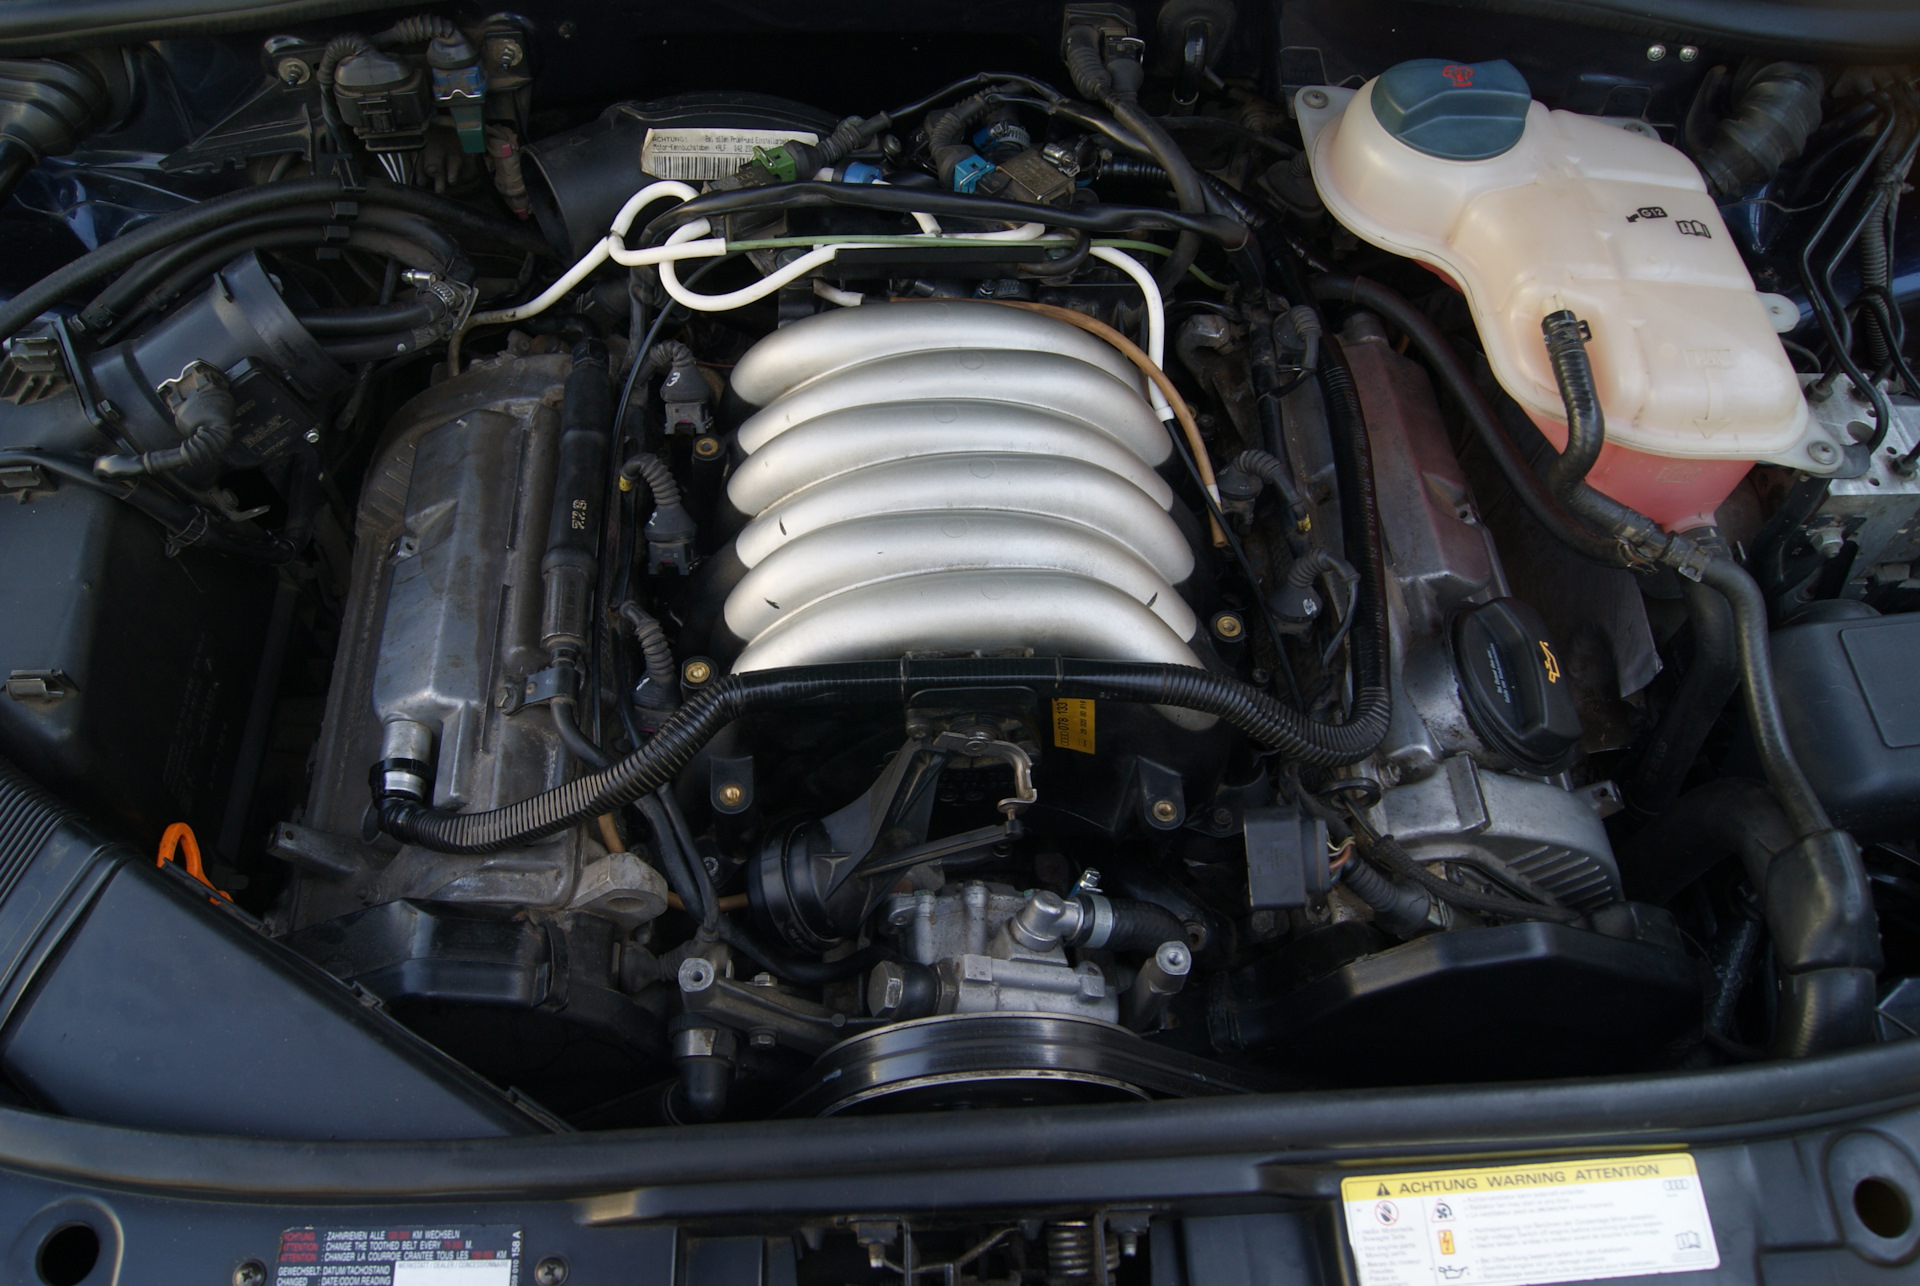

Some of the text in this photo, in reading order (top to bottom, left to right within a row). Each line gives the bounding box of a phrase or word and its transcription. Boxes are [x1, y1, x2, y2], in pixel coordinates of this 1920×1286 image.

[1640, 208, 1665, 217] G12
[666, 371, 680, 387] 3
[1056, 702, 1069, 730] 078 133
[1399, 1177, 1478, 1195] ACHTUNG
[1486, 1171, 1566, 1188] WARNING
[1575, 1164, 1660, 1182] ATTENTION
[369, 1231, 386, 1240] ALLE
[411, 1230, 422, 1239] KM
[425, 1230, 460, 1239] WECHSELN
[512, 1230, 521, 1239] A
[355, 1242, 367, 1251] THE
[369, 1241, 400, 1251] TOOTHED
[401, 1241, 418, 1250] BELT
[419, 1240, 442, 1249] EVERY
[511, 1240, 521, 1258] 158
[357, 1252, 366, 1261] LA
[436, 1251, 454, 1260] TOUS
[456, 1250, 469, 1259] LES
[496, 1250, 507, 1259] KM
[276, 1277, 308, 1286] CHANGED
